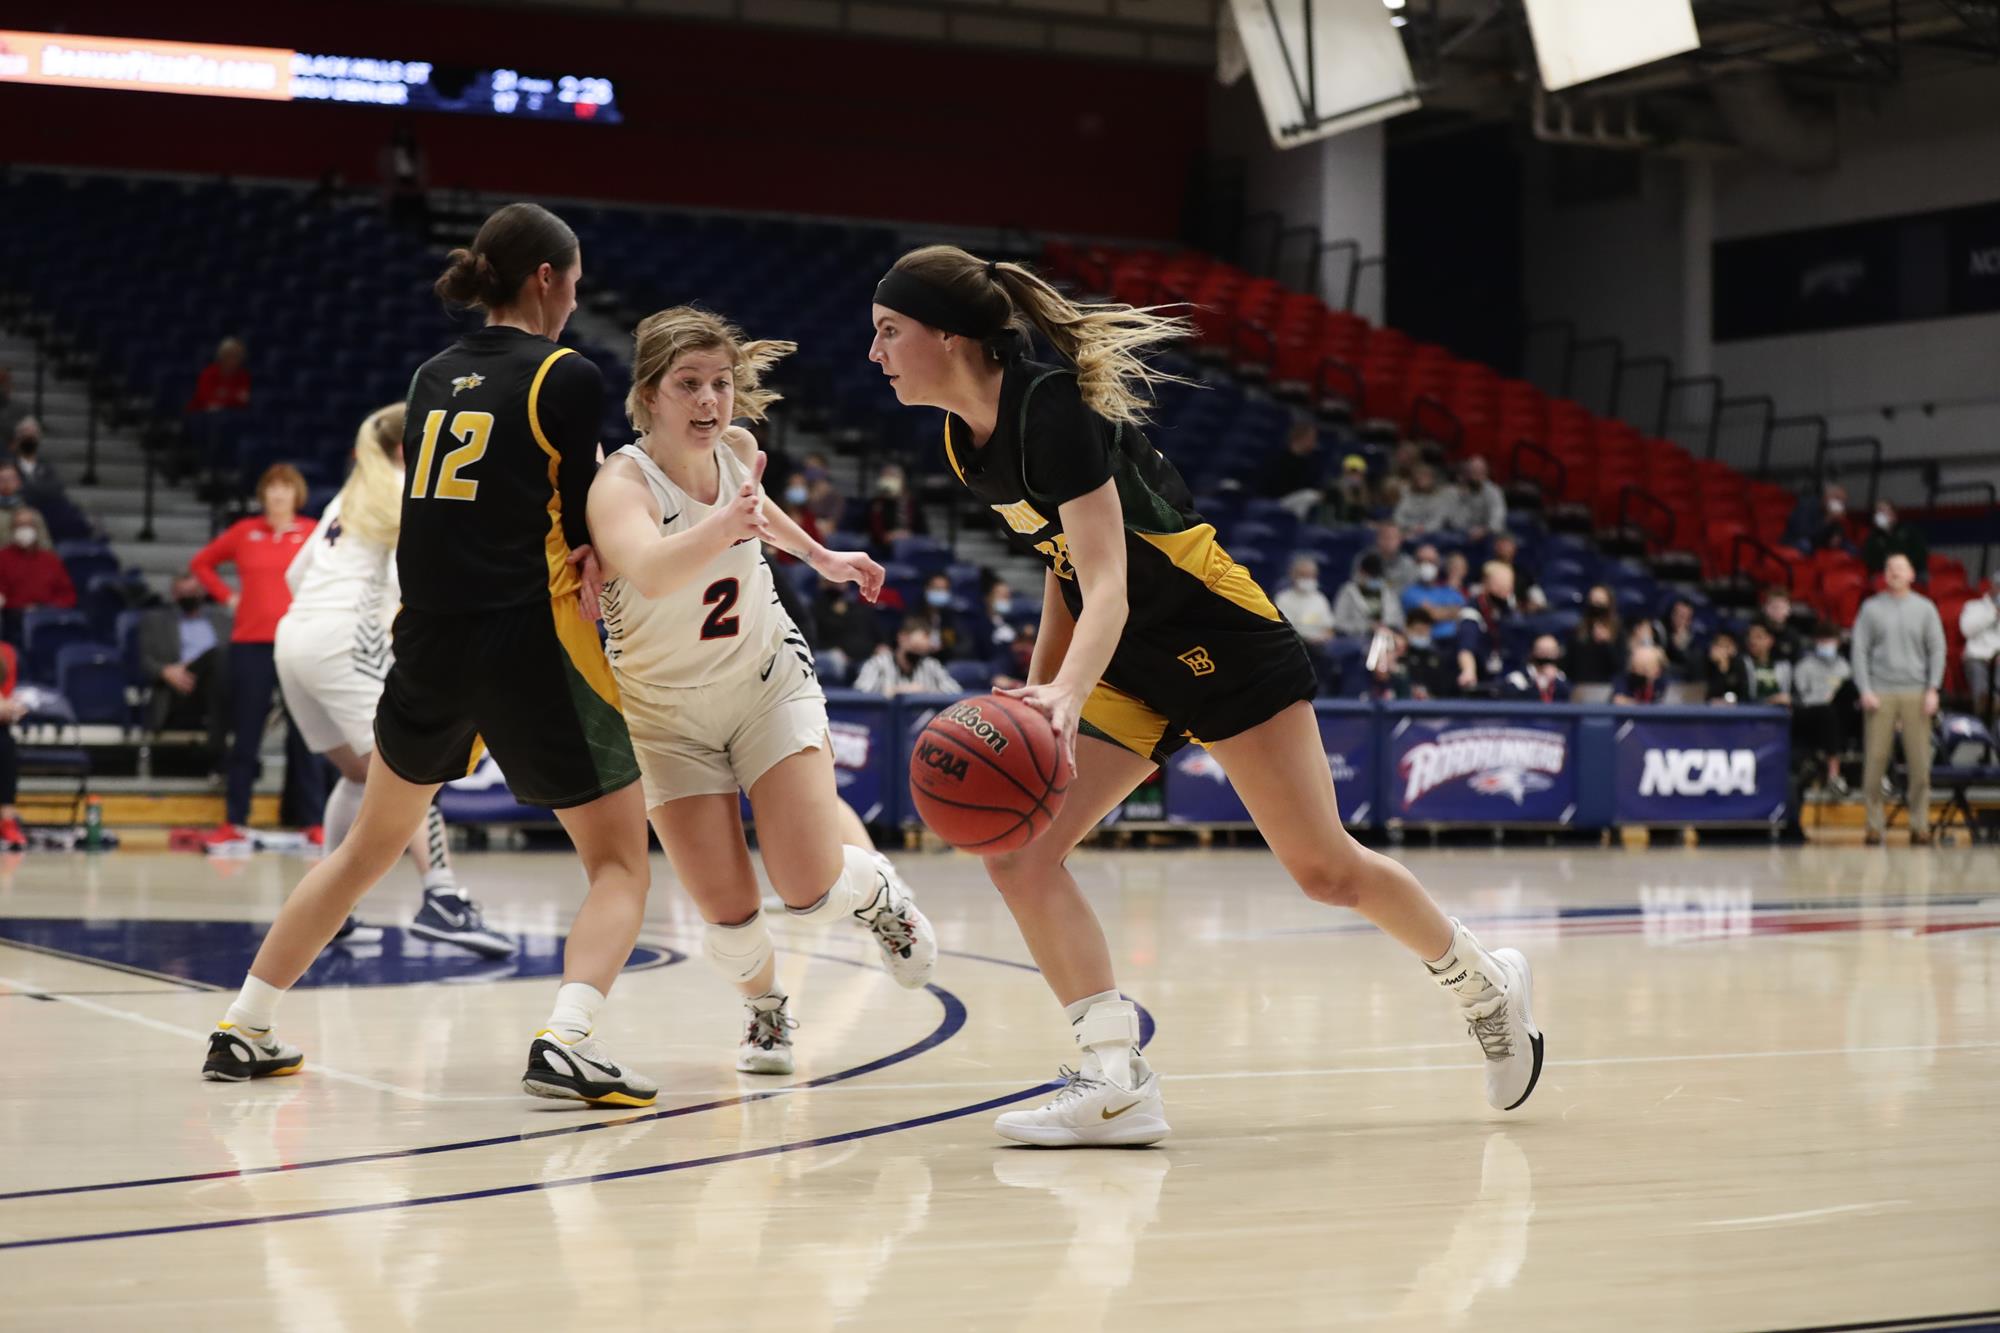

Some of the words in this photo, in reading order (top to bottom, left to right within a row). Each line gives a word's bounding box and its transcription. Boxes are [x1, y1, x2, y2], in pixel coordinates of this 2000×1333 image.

[410, 409, 495, 501] 12
[700, 577, 740, 641] 2
[917, 740, 969, 782] NCAA
[1639, 748, 1756, 796] NCAA
